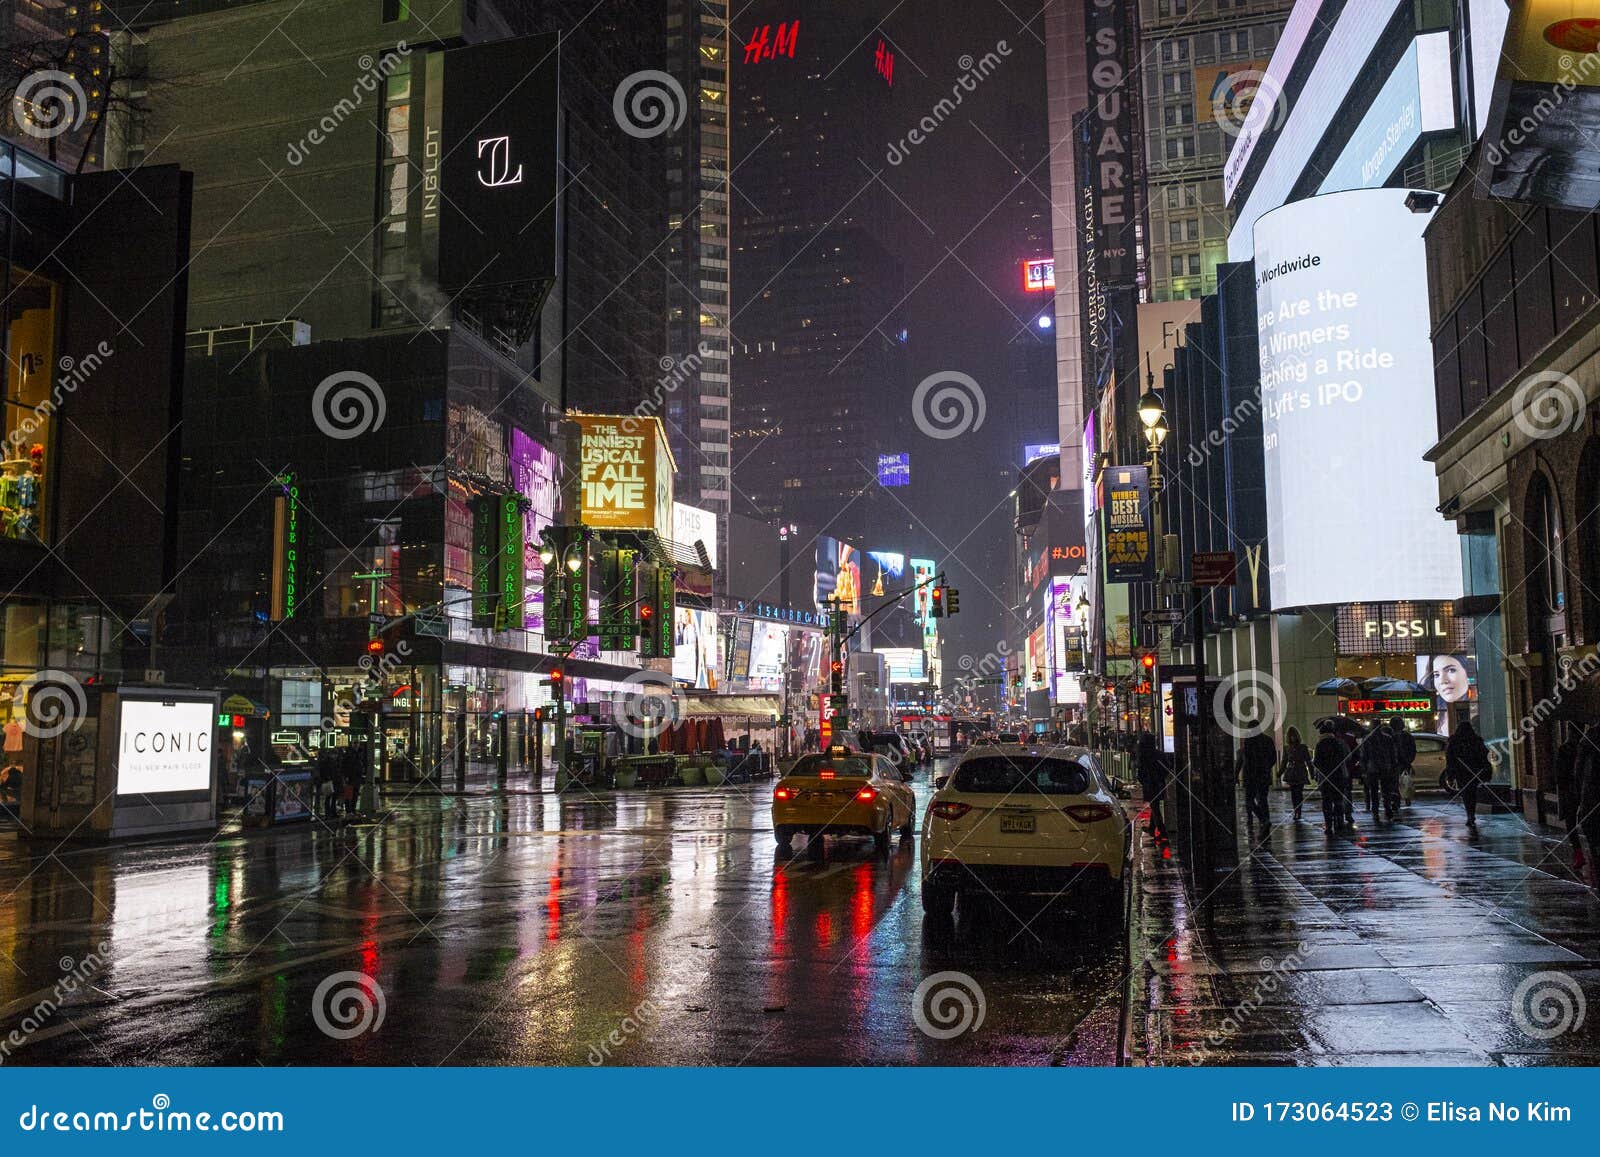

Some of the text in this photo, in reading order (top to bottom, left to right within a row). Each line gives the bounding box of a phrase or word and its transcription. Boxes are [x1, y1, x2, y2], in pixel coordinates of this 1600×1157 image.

[743, 20, 800, 64] H&M
[1092, 27, 1125, 225] SQUARE
[423, 126, 440, 219] INGLOT
[1103, 248, 1126, 258] NYC
[1083, 185, 1099, 348] AMERICAN EAGLE
[1261, 254, 1321, 284] Worldwide
[1258, 288, 1359, 331] ere Are the
[1270, 322, 1350, 356] Winners
[1315, 358, 1329, 376] a
[1336, 347, 1394, 373] Ride
[1269, 390, 1312, 420] Lyft's
[1318, 379, 1364, 406] IPO
[591, 425, 618, 435] THE
[581, 435, 645, 449] UNNIEST
[581, 448, 645, 464] USICAL
[582, 464, 645, 482] F ALL
[1112, 500, 1140, 515] BEST
[1110, 513, 1144, 525] MUSICAL
[1107, 531, 1148, 543] COME
[286, 486, 298, 619] OLIVE GARDEN
[1107, 542, 1148, 553] FROM
[1108, 552, 1149, 565] AWAY
[606, 626, 618, 634] 48
[393, 697, 421, 708] INGLT
[123, 732, 208, 754] ICONIC
